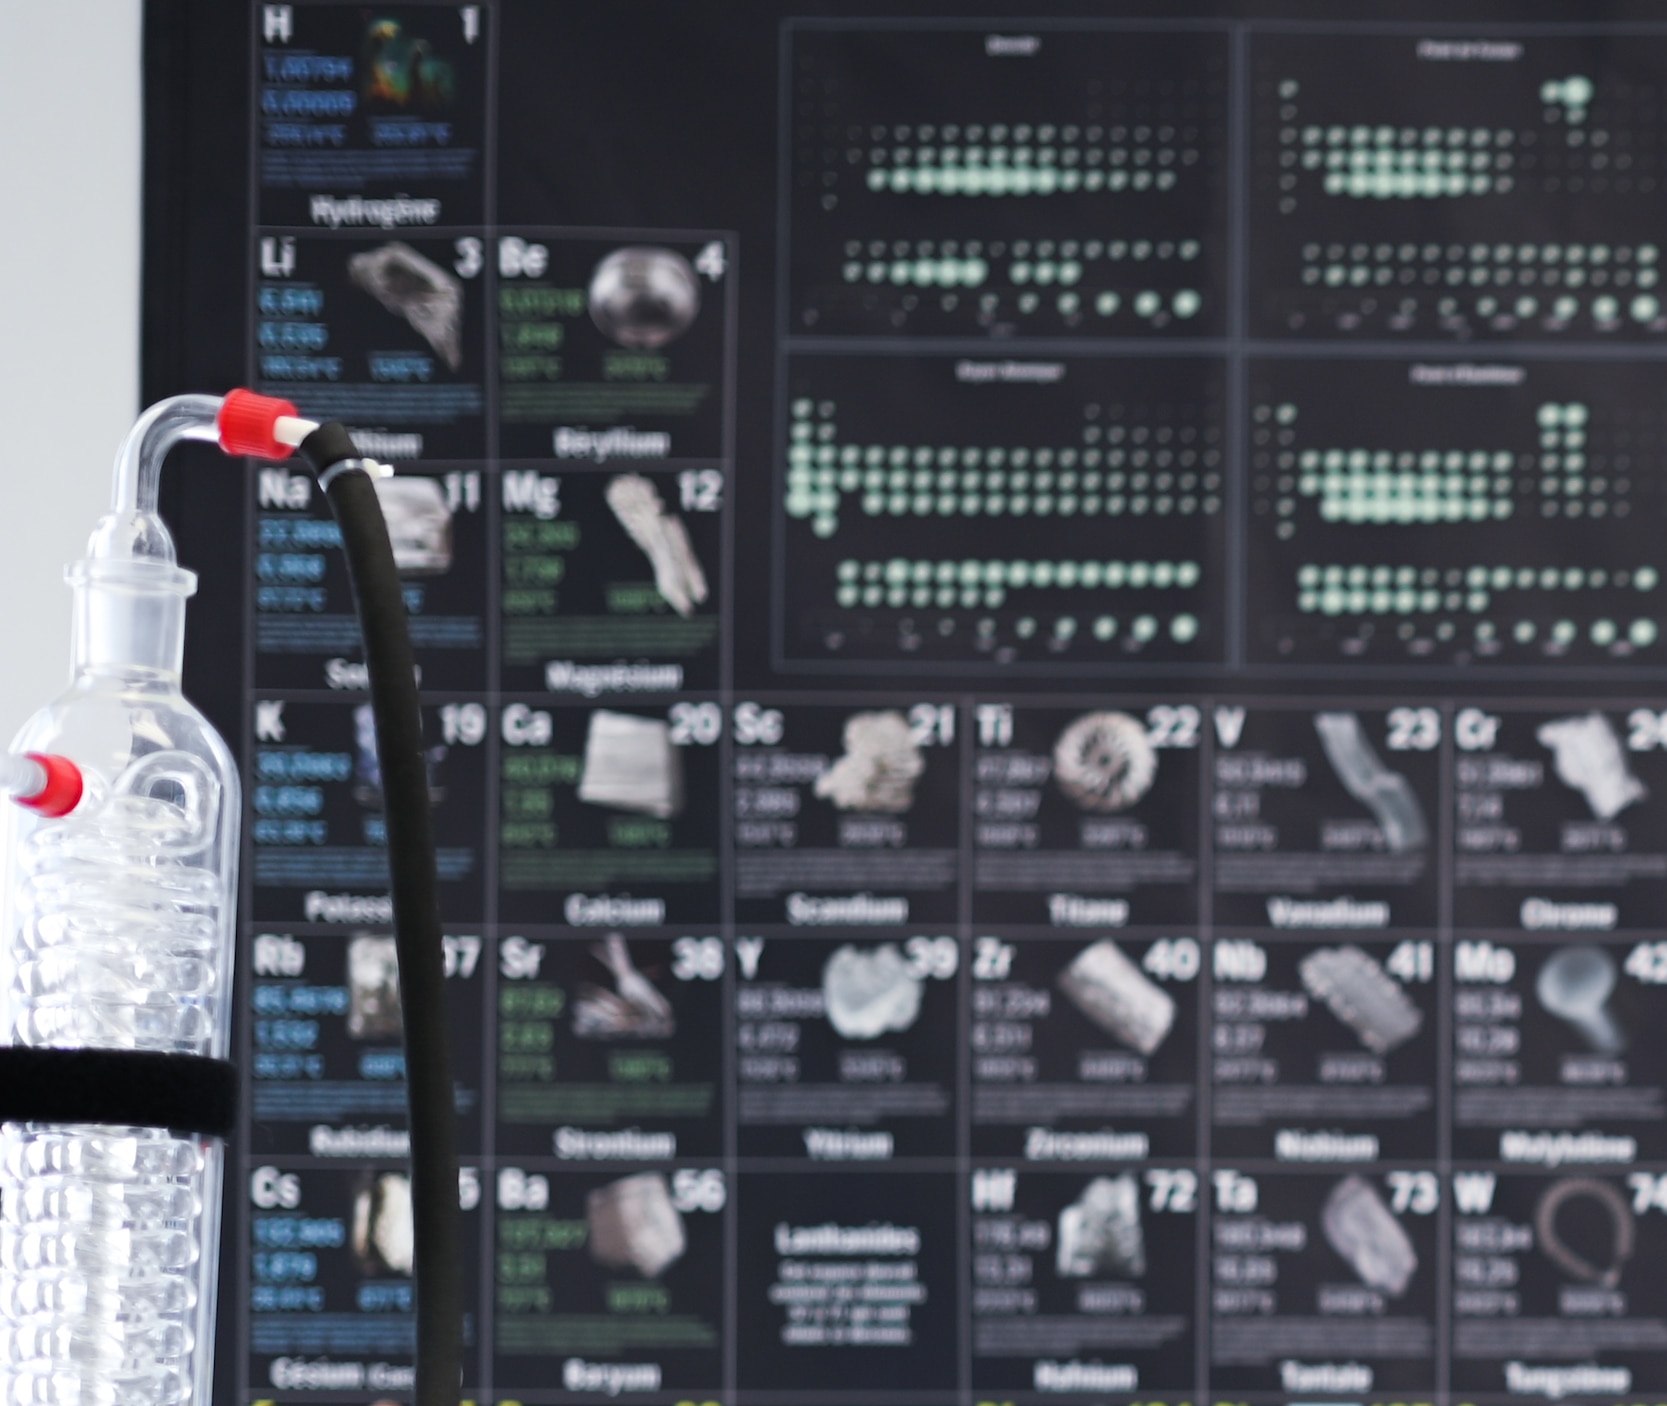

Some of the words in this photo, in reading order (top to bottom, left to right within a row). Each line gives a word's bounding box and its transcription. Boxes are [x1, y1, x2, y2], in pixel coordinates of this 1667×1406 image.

[264, 6, 291, 41] H
[462, 6, 478, 42] 1
[261, 237, 294, 275] Li
[499, 237, 547, 276] Be
[695, 242, 725, 279] 4
[259, 469, 310, 507] Na
[503, 471, 559, 519] Mg
[679, 470, 723, 510] 12
[256, 701, 283, 740] K
[442, 703, 486, 744] 19
[502, 704, 551, 744] Ca
[910, 704, 954, 747] 21
[977, 704, 1012, 744] Ti
[1147, 706, 1200, 750] 22
[1214, 708, 1244, 746] V
[1388, 708, 1441, 749] 23
[1455, 708, 1497, 749] Cr
[565, 894, 665, 926] Calcium
[1521, 899, 1616, 929] Chrome
[501, 936, 541, 978] Sr
[736, 938, 762, 977] Y
[1144, 938, 1200, 979] 40
[1214, 940, 1266, 980] Nb
[1386, 941, 1433, 980] 41
[1455, 941, 1515, 982] Mo
[251, 1166, 299, 1208] Cs
[498, 1168, 548, 1209] Ba
[1147, 1169, 1197, 1212] 72
[1214, 1170, 1257, 1211] Ta
[1386, 1171, 1439, 1212] 73
[1454, 1173, 1495, 1212] W
